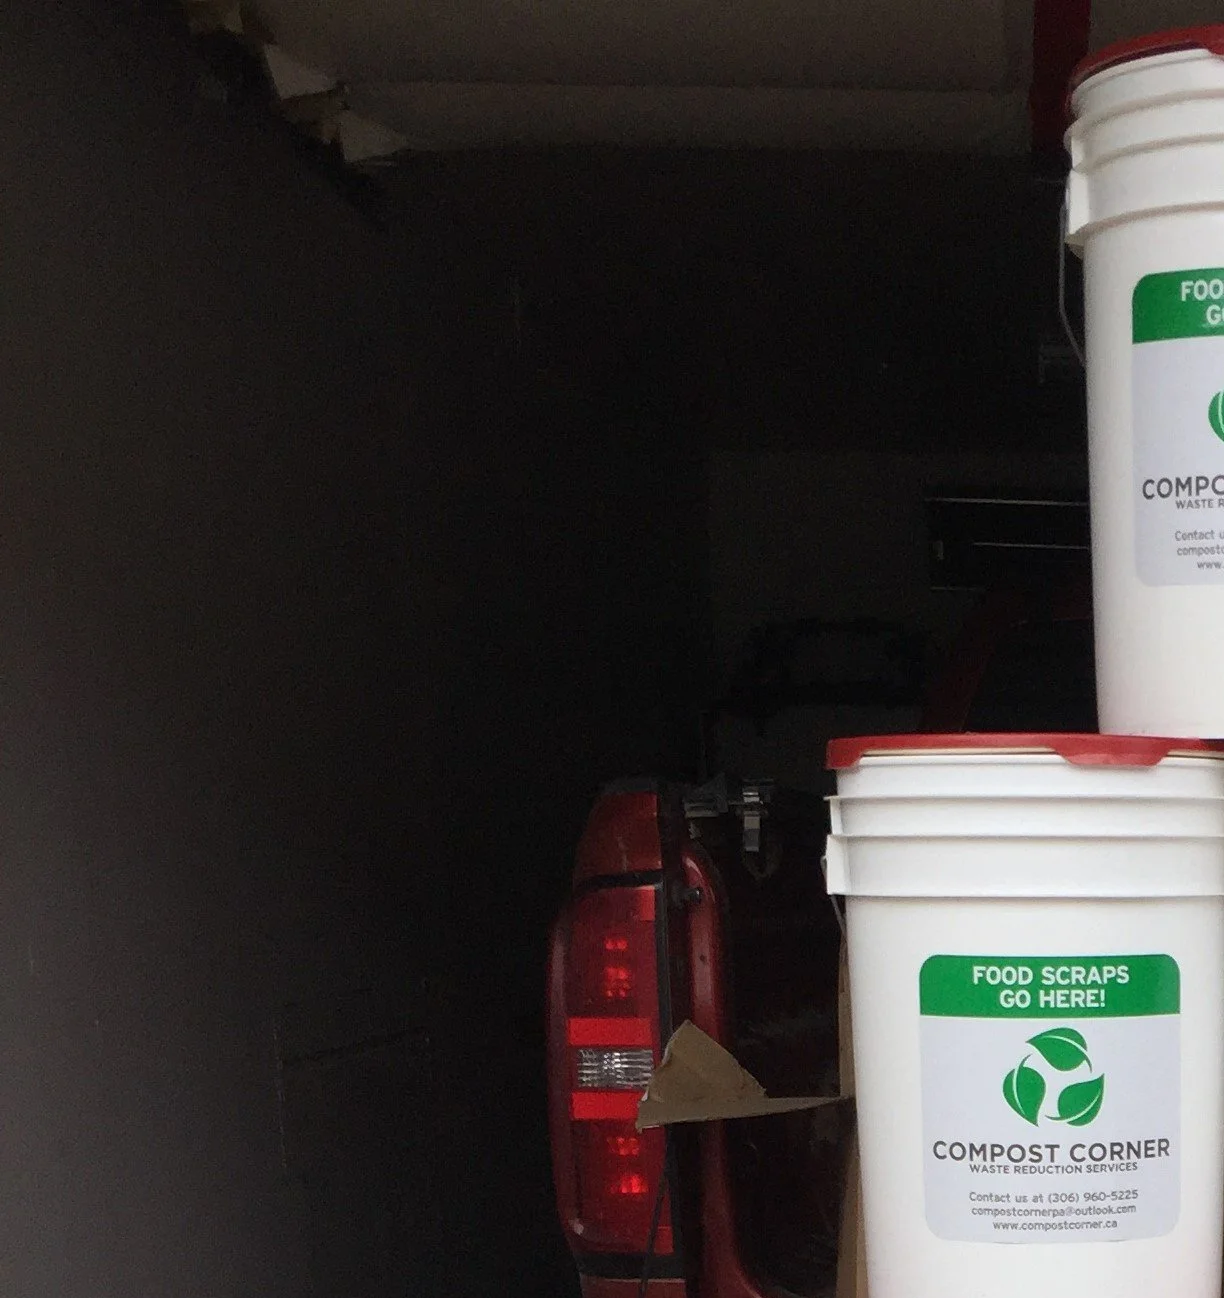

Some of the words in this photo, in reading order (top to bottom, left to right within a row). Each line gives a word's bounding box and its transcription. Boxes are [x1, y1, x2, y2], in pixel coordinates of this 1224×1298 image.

[1175, 498, 1213, 509] WASTE
[1175, 530, 1214, 541] Contact
[973, 966, 1033, 985] FOOD
[1042, 966, 1129, 985] SCRAPS
[1001, 990, 1031, 1008] GO
[1040, 989, 1105, 1007] HERE!
[933, 1141, 1059, 1163] COMPOST
[1070, 1138, 1170, 1162] CORNER
[970, 1164, 1010, 1174] WASTE
[1014, 1165, 1082, 1174] REDUCTION
[1086, 1162, 1138, 1173] SERVICES
[969, 1192, 1010, 1203] Contact
[1015, 1195, 1027, 1203] us
[1032, 1193, 1043, 1203] at
[1048, 1192, 1079, 1204] (306)
[1083, 1190, 1139, 1202] 960-5225
[993, 1220, 1117, 1231] www.compostcorner.ca
